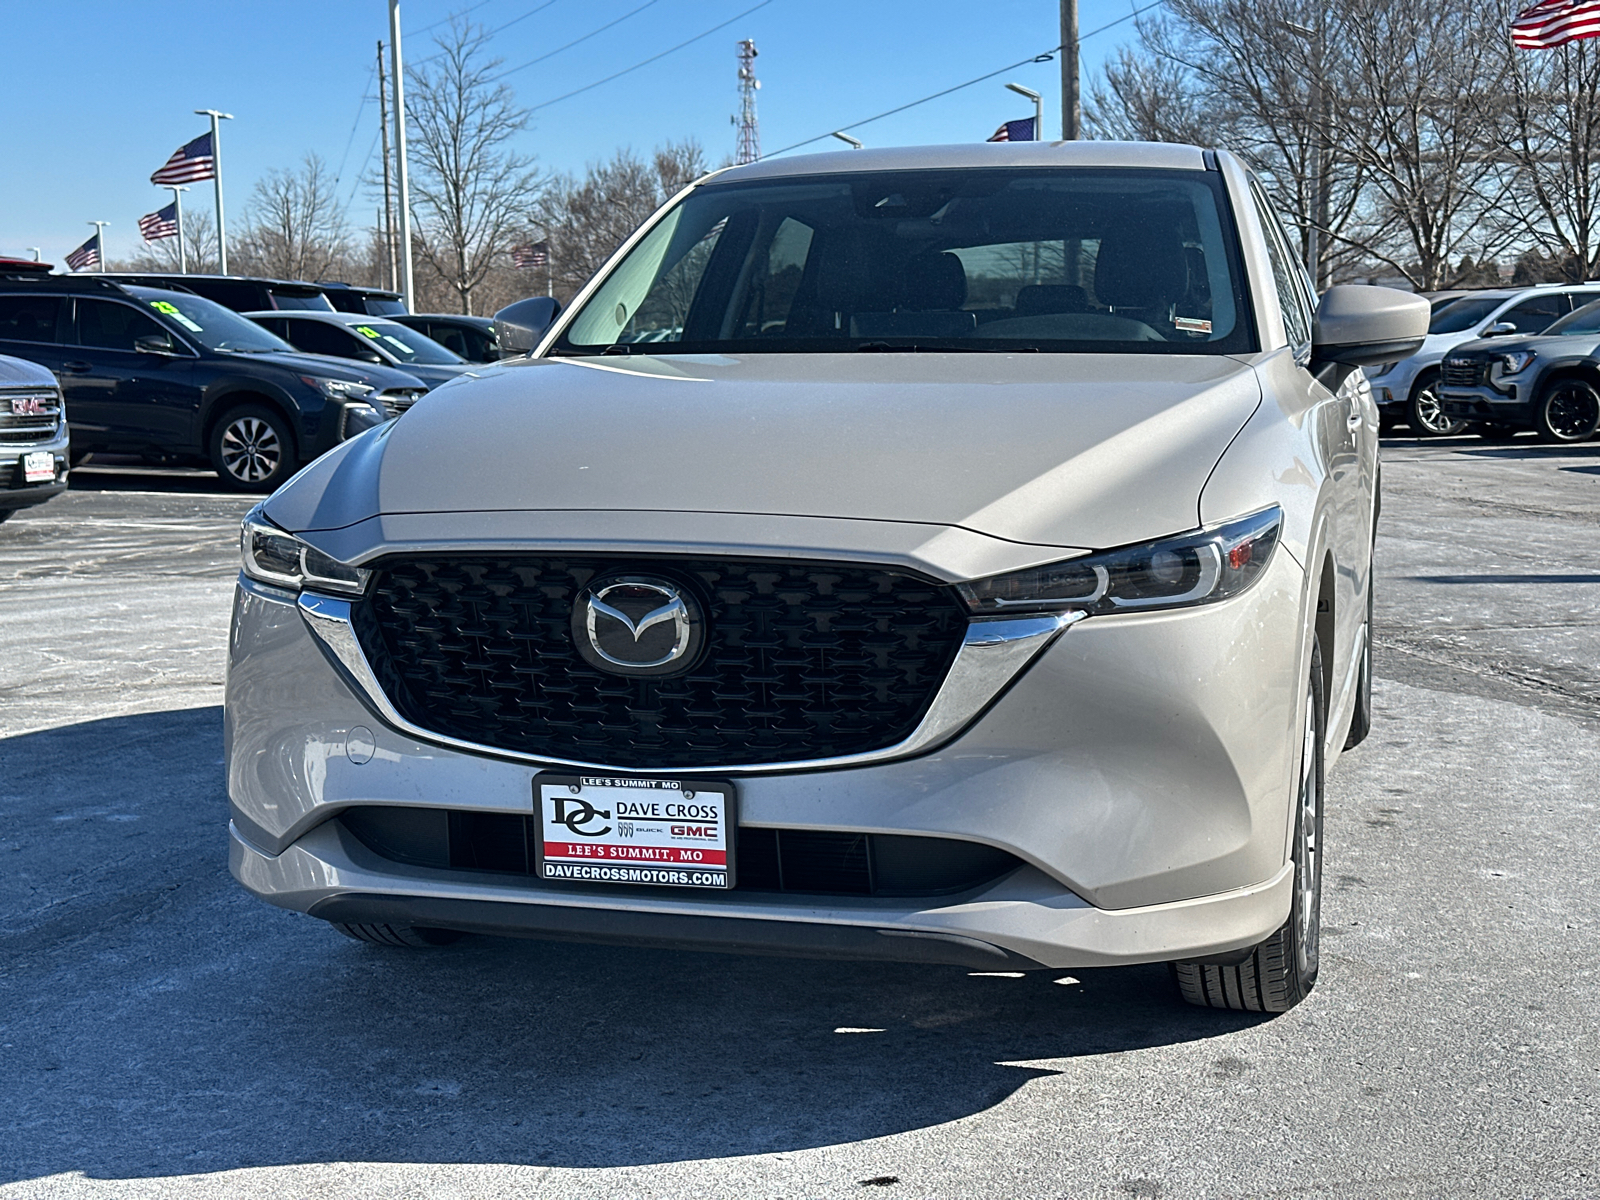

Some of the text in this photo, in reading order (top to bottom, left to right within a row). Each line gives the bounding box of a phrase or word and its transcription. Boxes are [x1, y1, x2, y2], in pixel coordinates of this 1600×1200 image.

[582, 778, 611, 787] LEE'S
[614, 779, 658, 788] SUMMIT
[617, 802, 718, 819] DAVE CROSS
[671, 825, 718, 837] GMC
[610, 846, 674, 862] SUMMIT,
[680, 850, 703, 861] MO
[545, 864, 725, 886] DAVECROSSMOTORS.COM
